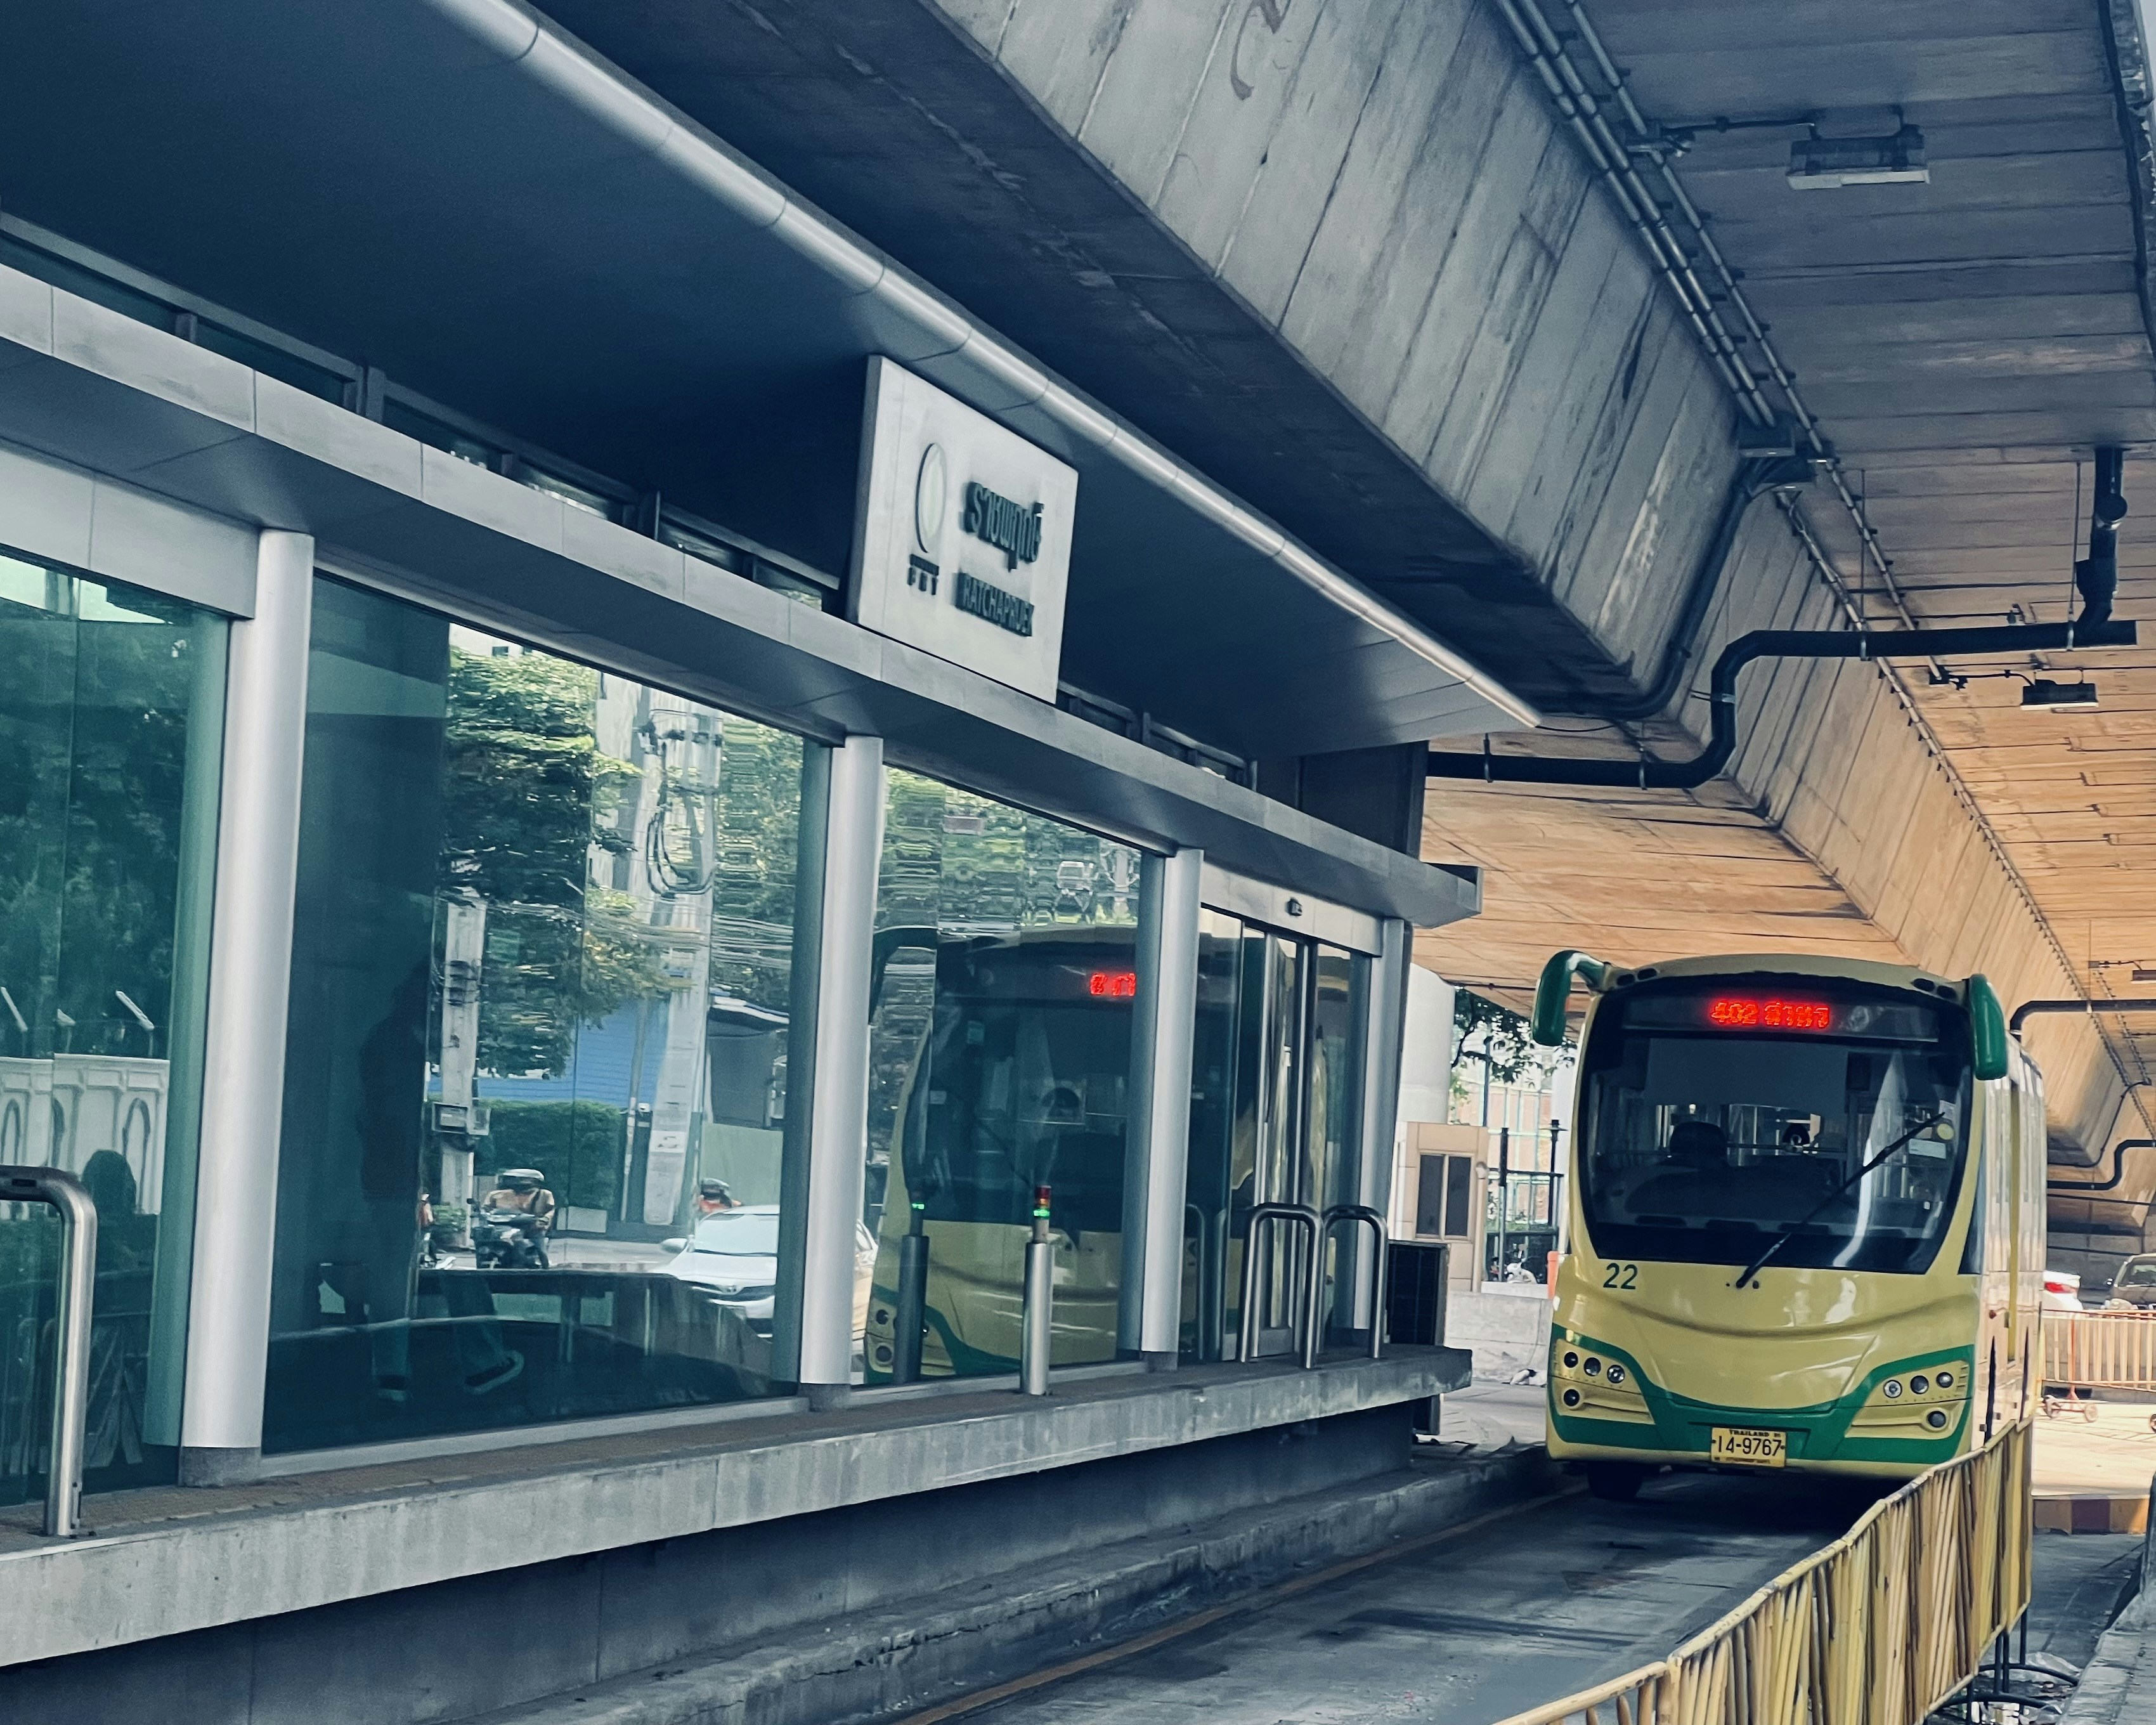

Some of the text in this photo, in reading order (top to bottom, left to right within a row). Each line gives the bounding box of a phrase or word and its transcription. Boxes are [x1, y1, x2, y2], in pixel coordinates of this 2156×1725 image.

[1711, 1001, 1758, 1025] 402
[1602, 1262, 1638, 1290] 22
[1718, 1435, 1782, 1457] 14-9767
